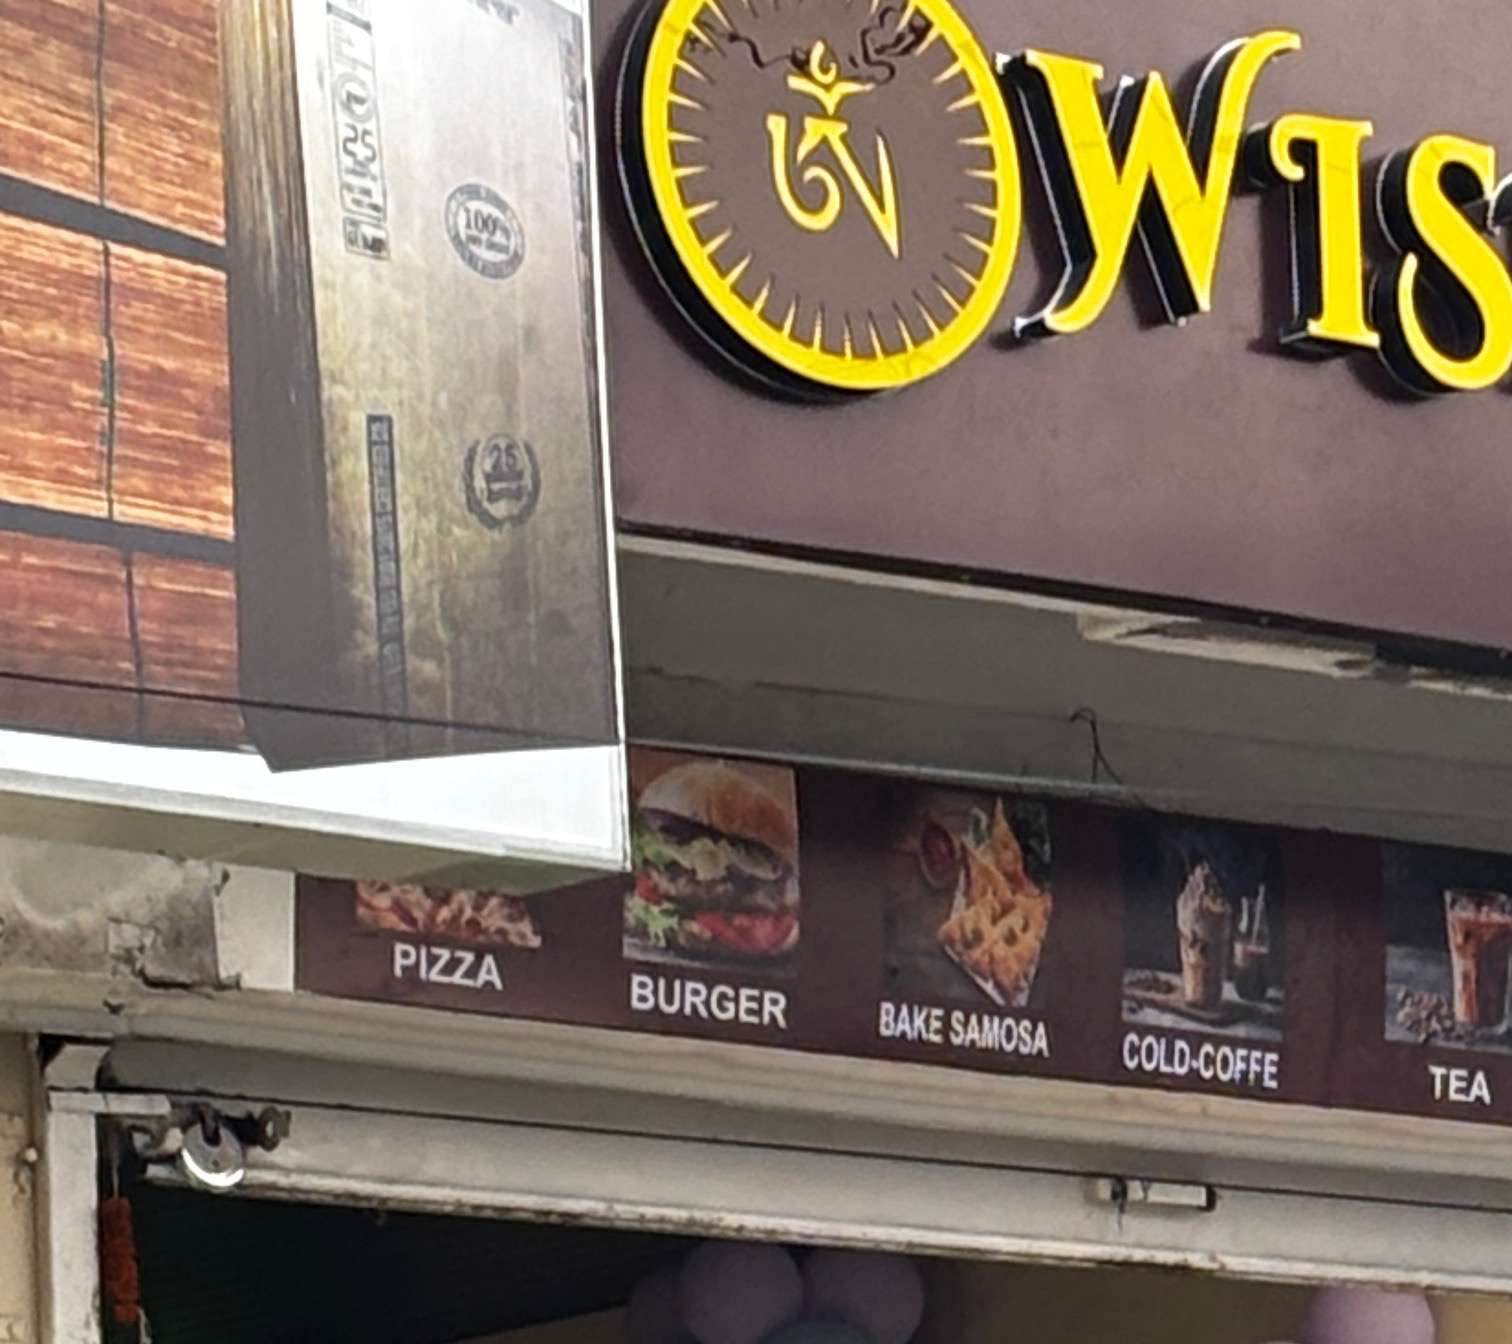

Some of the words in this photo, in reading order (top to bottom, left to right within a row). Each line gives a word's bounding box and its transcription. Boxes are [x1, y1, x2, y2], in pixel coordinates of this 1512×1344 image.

[393, 942, 503, 991] PIZZA
[629, 974, 789, 1029] BURGER
[878, 1001, 944, 1043] BAKE
[948, 1010, 1049, 1059] SAMOSA
[1121, 1033, 1280, 1089] COLD-COFFE
[1428, 1064, 1491, 1106] TEA
